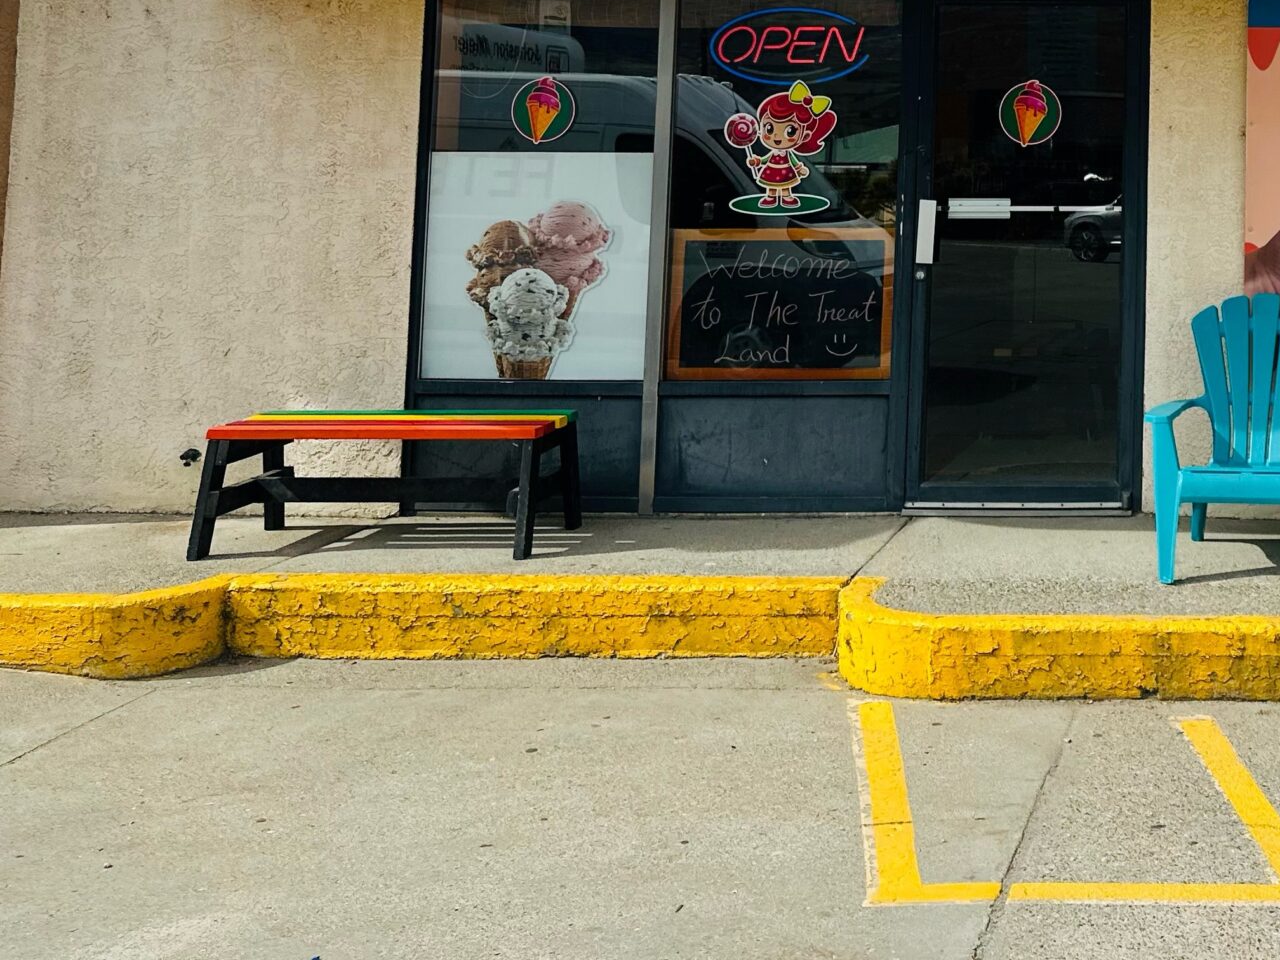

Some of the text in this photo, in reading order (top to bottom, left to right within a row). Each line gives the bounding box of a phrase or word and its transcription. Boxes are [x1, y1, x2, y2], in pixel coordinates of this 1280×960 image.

[717, 26, 865, 63] OPEN
[700, 244, 858, 279] Welcome
[691, 286, 877, 329] to The Treat
[714, 334, 790, 364] Land
